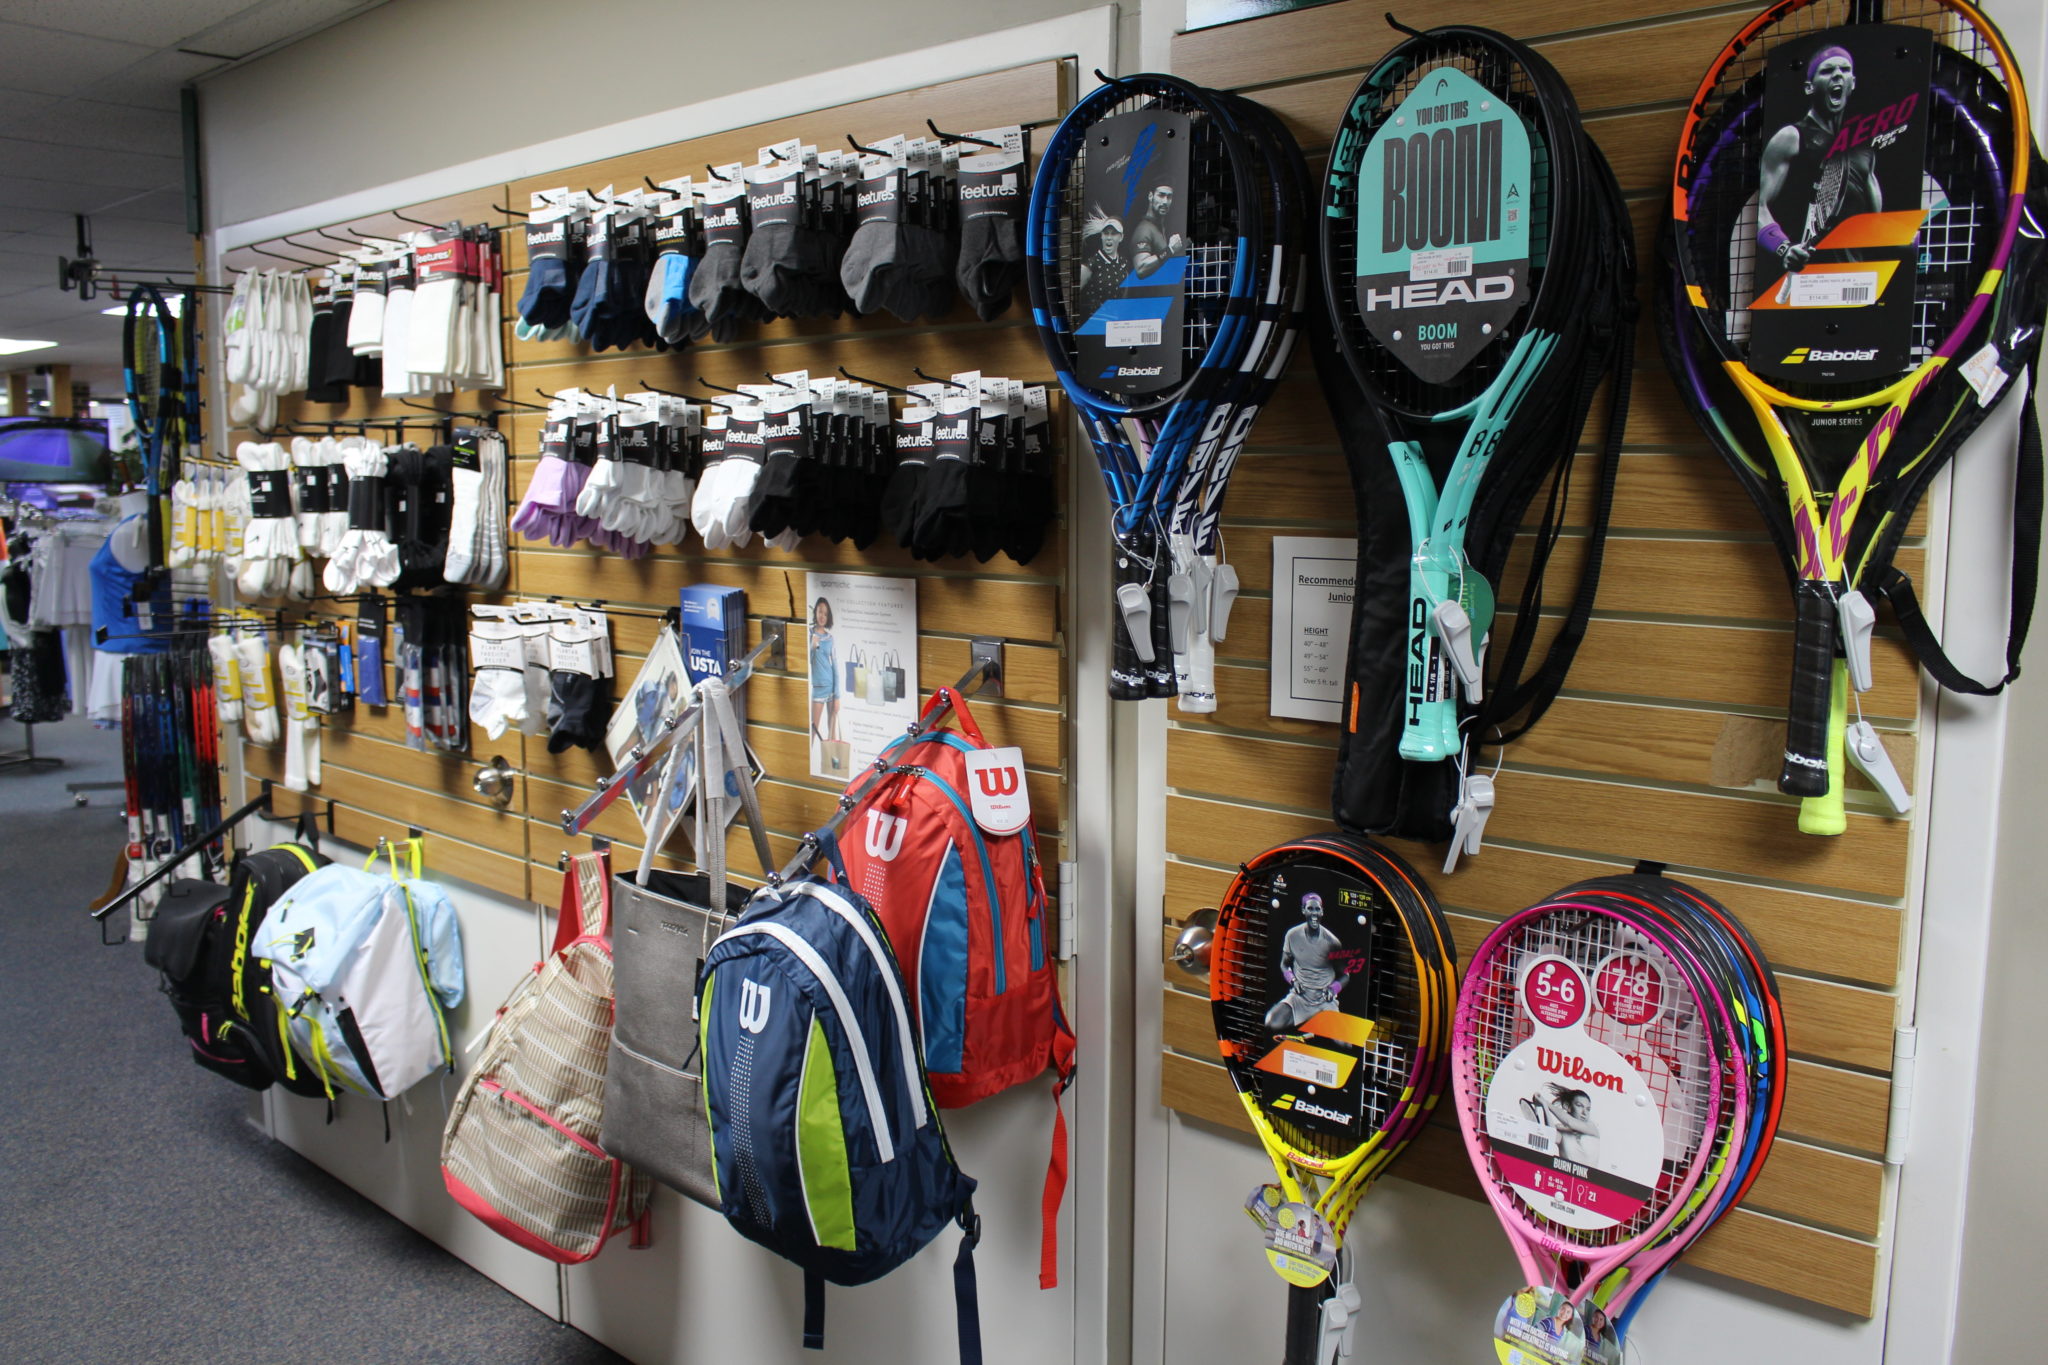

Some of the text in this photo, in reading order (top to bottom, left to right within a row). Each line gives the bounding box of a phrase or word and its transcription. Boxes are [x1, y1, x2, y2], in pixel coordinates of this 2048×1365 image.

[1416, 102, 1469, 126] YOU GOT THIS
[1824, 92, 1919, 160] AERO
[961, 184, 1017, 201] feetures
[1382, 119, 1503, 254] BOOM
[752, 194, 794, 210] feetures
[858, 190, 895, 207] feetures
[704, 212, 740, 229] feetures
[527, 229, 565, 246] feetures
[1367, 275, 1515, 312] HEAD
[1418, 323, 1458, 341] BOOM
[1420, 343, 1431, 351] YOU
[1431, 342, 1442, 350] GOT
[765, 423, 802, 438] feetures
[1811, 418, 1863, 426] JUNIOR SERIES
[726, 429, 765, 445] feetures
[896, 434, 935, 448] feetures
[935, 424, 969, 441] feetures
[1304, 627, 1328, 635] HEIGHT
[690, 655, 723, 676] USTA
[1409, 598, 1426, 725] HEAD
[1344, 957, 1366, 974] 23
[1536, 971, 1575, 1003] 5-6
[1612, 967, 1649, 997] 7-8
[1537, 1046, 1625, 1094] Wilson
[1553, 1158, 1588, 1179] BURN PINK
[1588, 1191, 1596, 1202] 21
[1550, 1201, 1576, 1215] WILSON.COM
